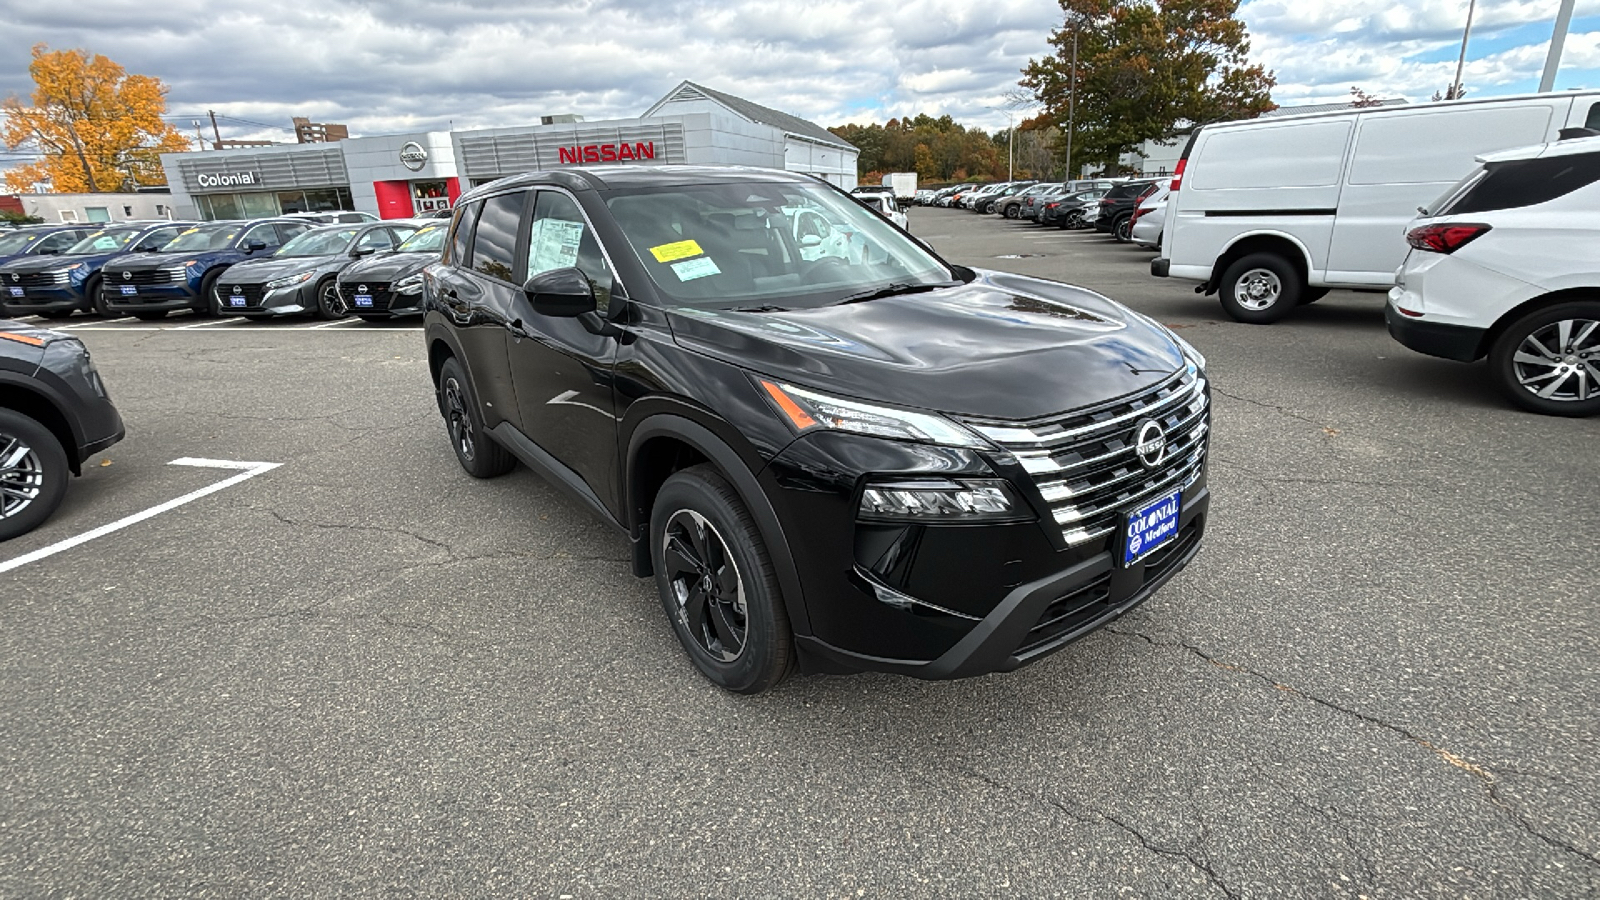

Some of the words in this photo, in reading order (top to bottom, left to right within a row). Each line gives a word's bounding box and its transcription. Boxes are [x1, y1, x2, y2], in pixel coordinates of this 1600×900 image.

[558, 141, 654, 164] NISSAN
[198, 171, 256, 187] Colonial
[1128, 500, 1178, 537] COLONIAL
[1145, 517, 1175, 544] Medford
